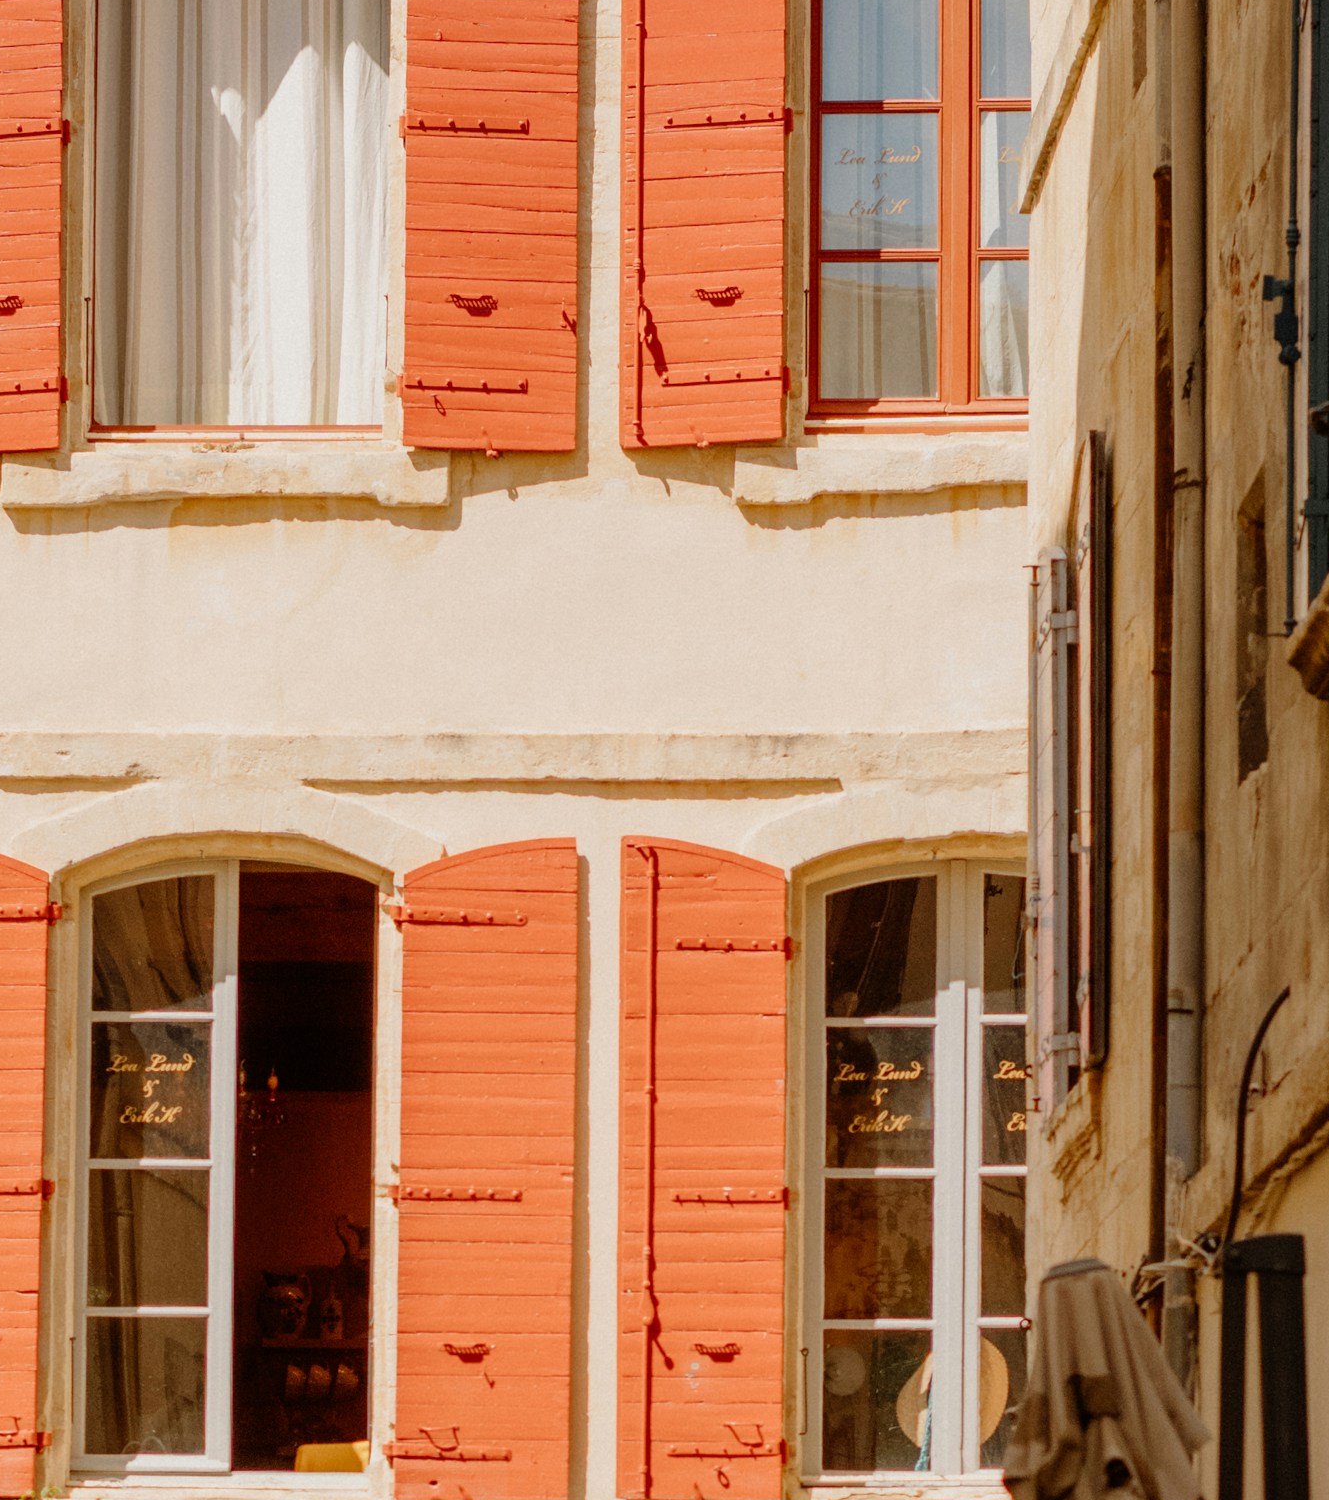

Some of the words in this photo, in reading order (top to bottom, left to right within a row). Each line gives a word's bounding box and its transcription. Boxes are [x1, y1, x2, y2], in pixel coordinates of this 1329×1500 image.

[874, 145, 922, 165] Lund
[106, 1054, 139, 1072] Lea
[145, 1053, 196, 1072] Lund
[833, 1063, 869, 1081] Lea
[873, 1060, 924, 1081] Lund
[993, 1060, 1026, 1079] Lea
[143, 1079, 160, 1098] &
[871, 1087, 888, 1106] &
[120, 1101, 160, 1124] Erik
[154, 1105, 183, 1124] K
[848, 1109, 888, 1134] Erik
[884, 1113, 912, 1132] K
